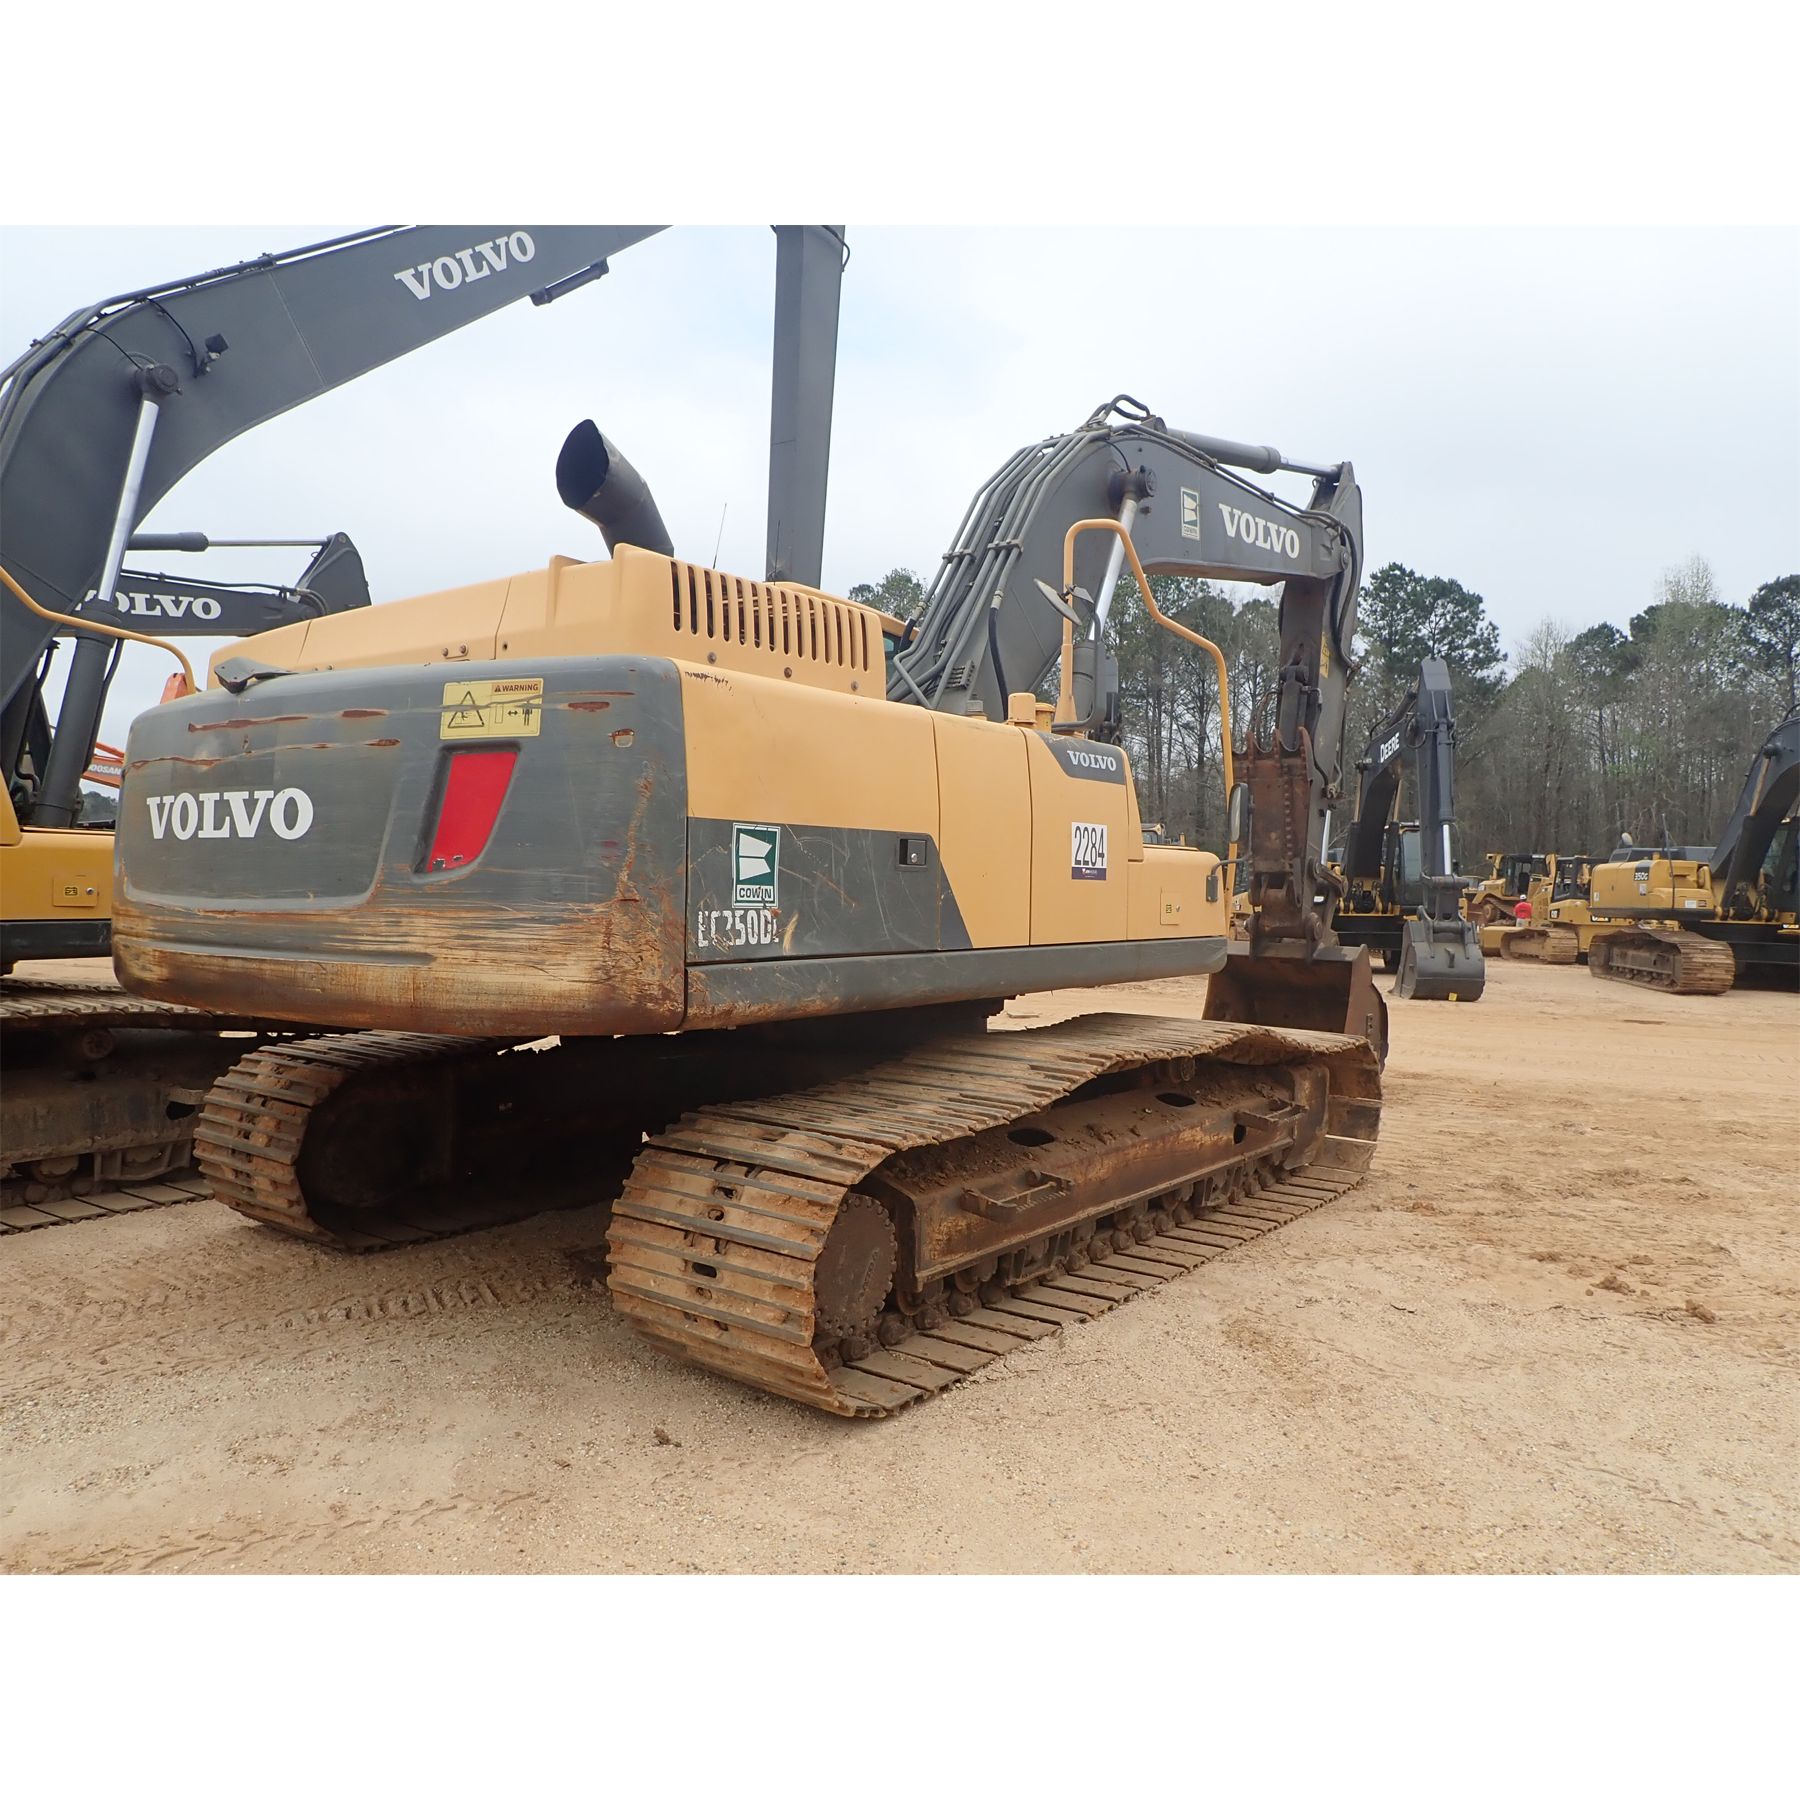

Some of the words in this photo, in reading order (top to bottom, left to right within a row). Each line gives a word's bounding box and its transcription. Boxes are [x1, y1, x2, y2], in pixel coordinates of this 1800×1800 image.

[394, 231, 535, 300] VOLVO
[1218, 503, 1300, 559] VOLVO
[75, 589, 222, 620] LVO
[502, 684, 539, 692] WARNING
[1067, 750, 1117, 771] VOLVO
[1380, 731, 1400, 763] DEERE
[146, 787, 314, 840] VOLVO
[1074, 825, 1105, 867] 2284
[739, 887, 772, 899] COWIN
